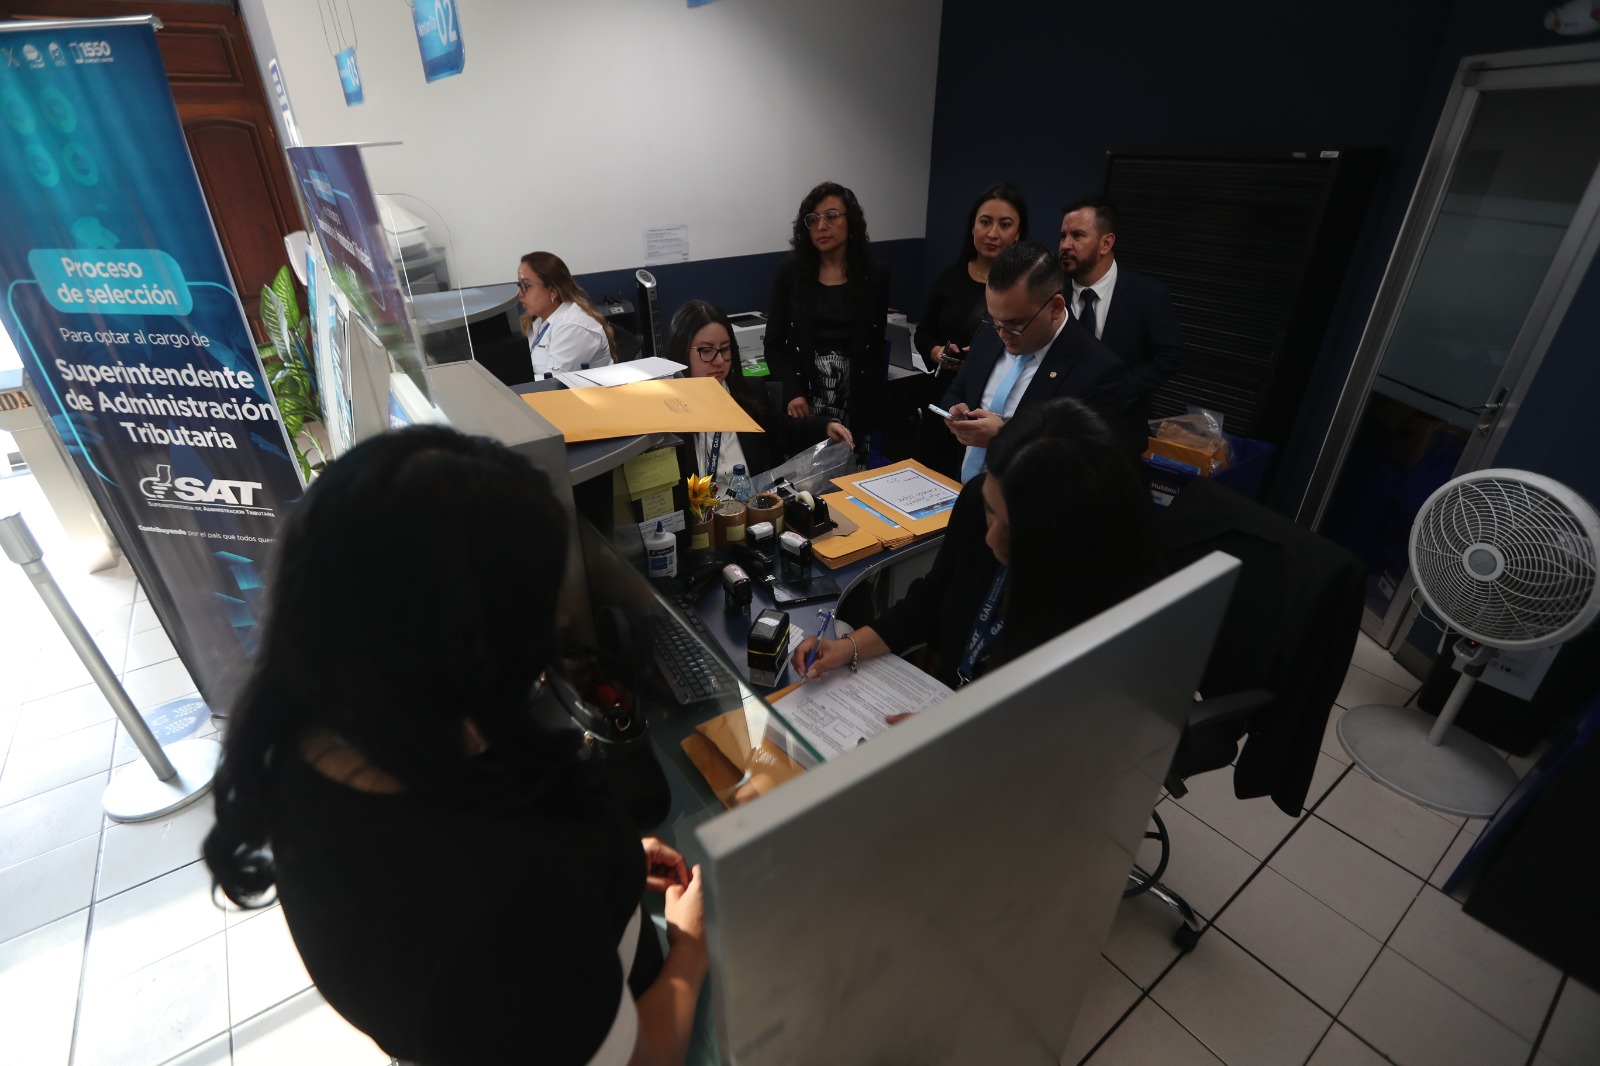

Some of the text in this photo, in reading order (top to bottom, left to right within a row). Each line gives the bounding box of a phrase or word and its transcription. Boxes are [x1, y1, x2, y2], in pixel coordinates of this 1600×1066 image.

[434, 0, 458, 46] 02
[78, 41, 111, 57] 1550
[60, 257, 143, 278] Proceso
[57, 282, 178, 305] de selección
[59, 327, 211, 349] Para optar al cargo de
[55, 358, 255, 390] Superintendente
[65, 389, 278, 421] de Administración
[119, 421, 238, 449] Tributaria
[173, 476, 263, 506] SAT
[236, 534, 257, 542] todos
[980, 602, 993, 622] GAI
